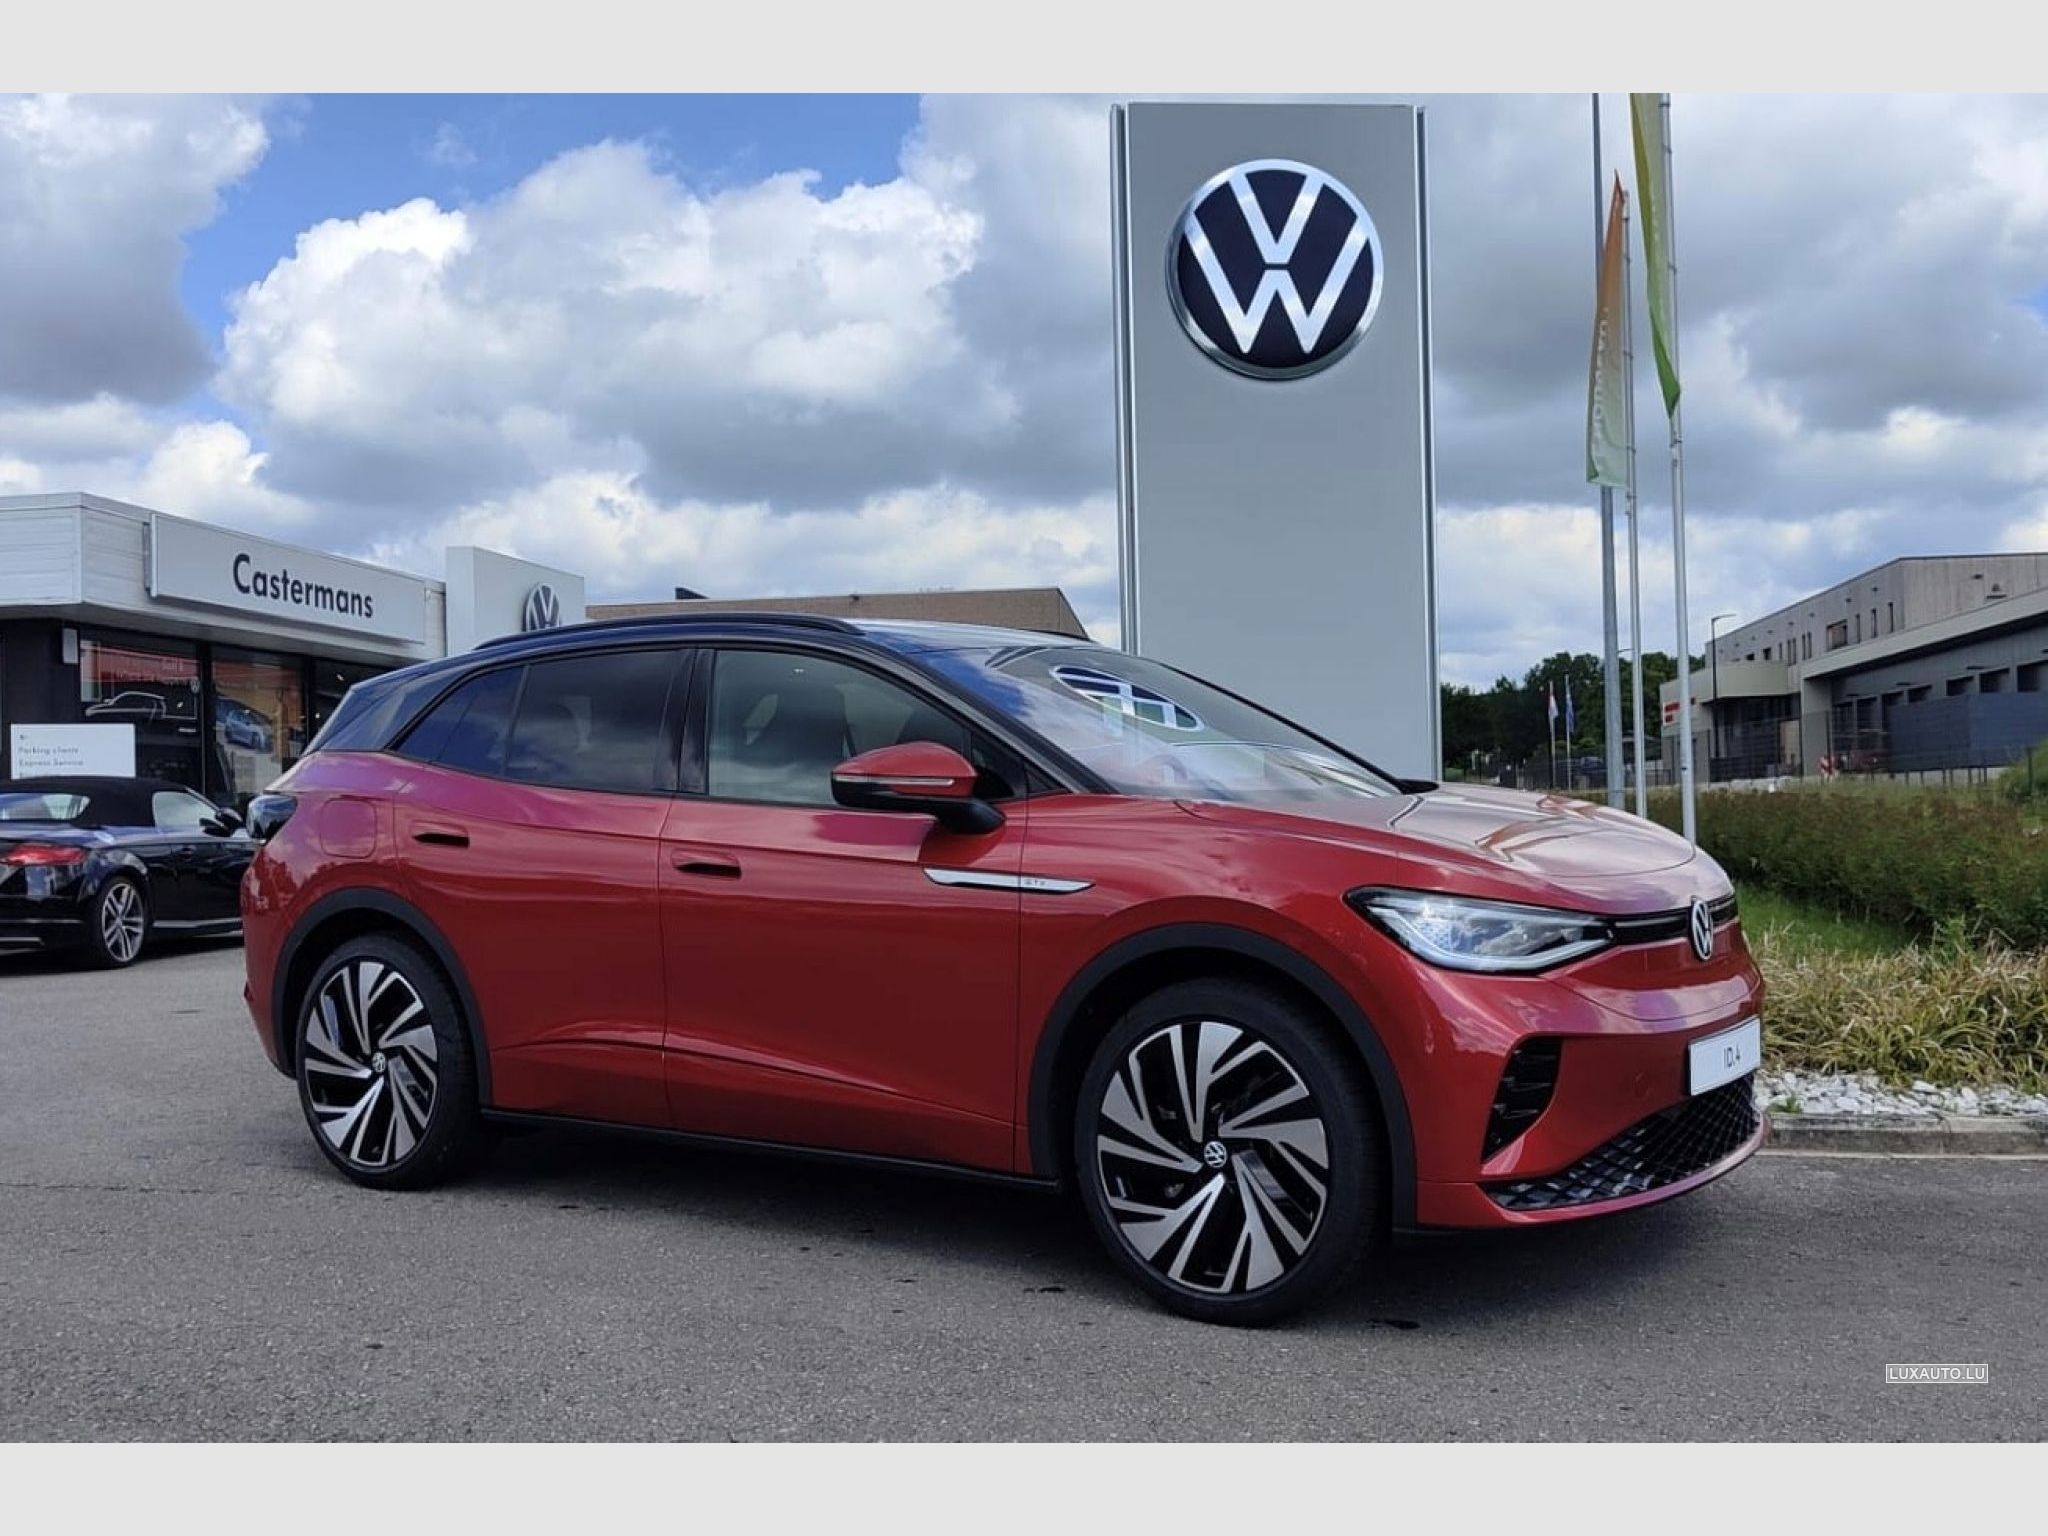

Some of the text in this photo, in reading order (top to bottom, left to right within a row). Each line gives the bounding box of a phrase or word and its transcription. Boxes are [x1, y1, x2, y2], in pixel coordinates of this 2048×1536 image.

[1171, 162, 1380, 370] VW
[232, 552, 374, 618] Castermans
[18, 745, 51, 756] Parking
[1723, 1043, 1741, 1073] ID.4
